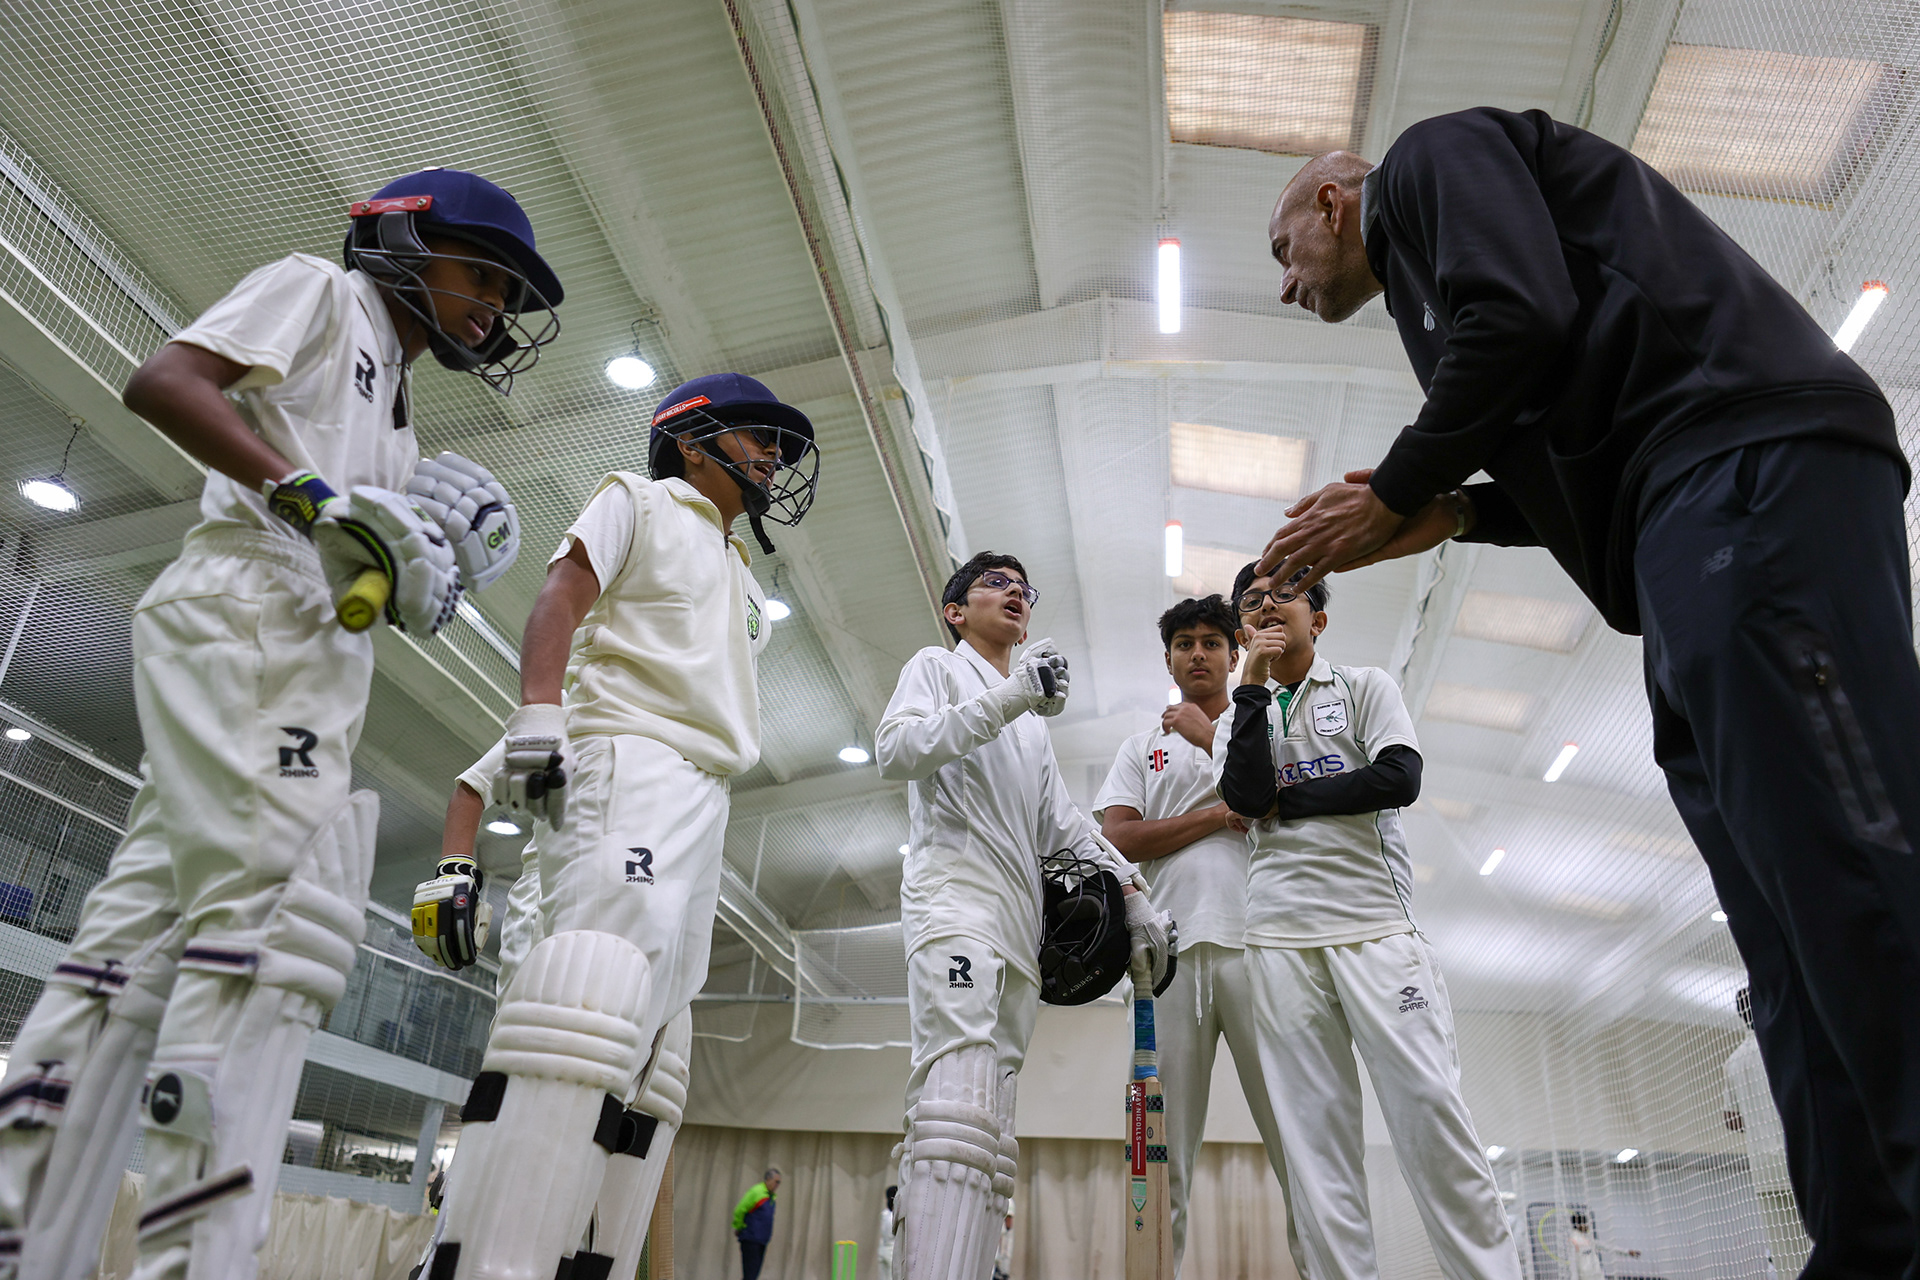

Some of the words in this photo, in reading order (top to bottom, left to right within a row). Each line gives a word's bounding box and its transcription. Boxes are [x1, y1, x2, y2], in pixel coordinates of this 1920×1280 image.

[487, 520, 511, 550] GM
[279, 768, 320, 779] RHINO
[625, 875, 655, 886] RHINO
[1398, 1000, 1429, 1014] SHREY
